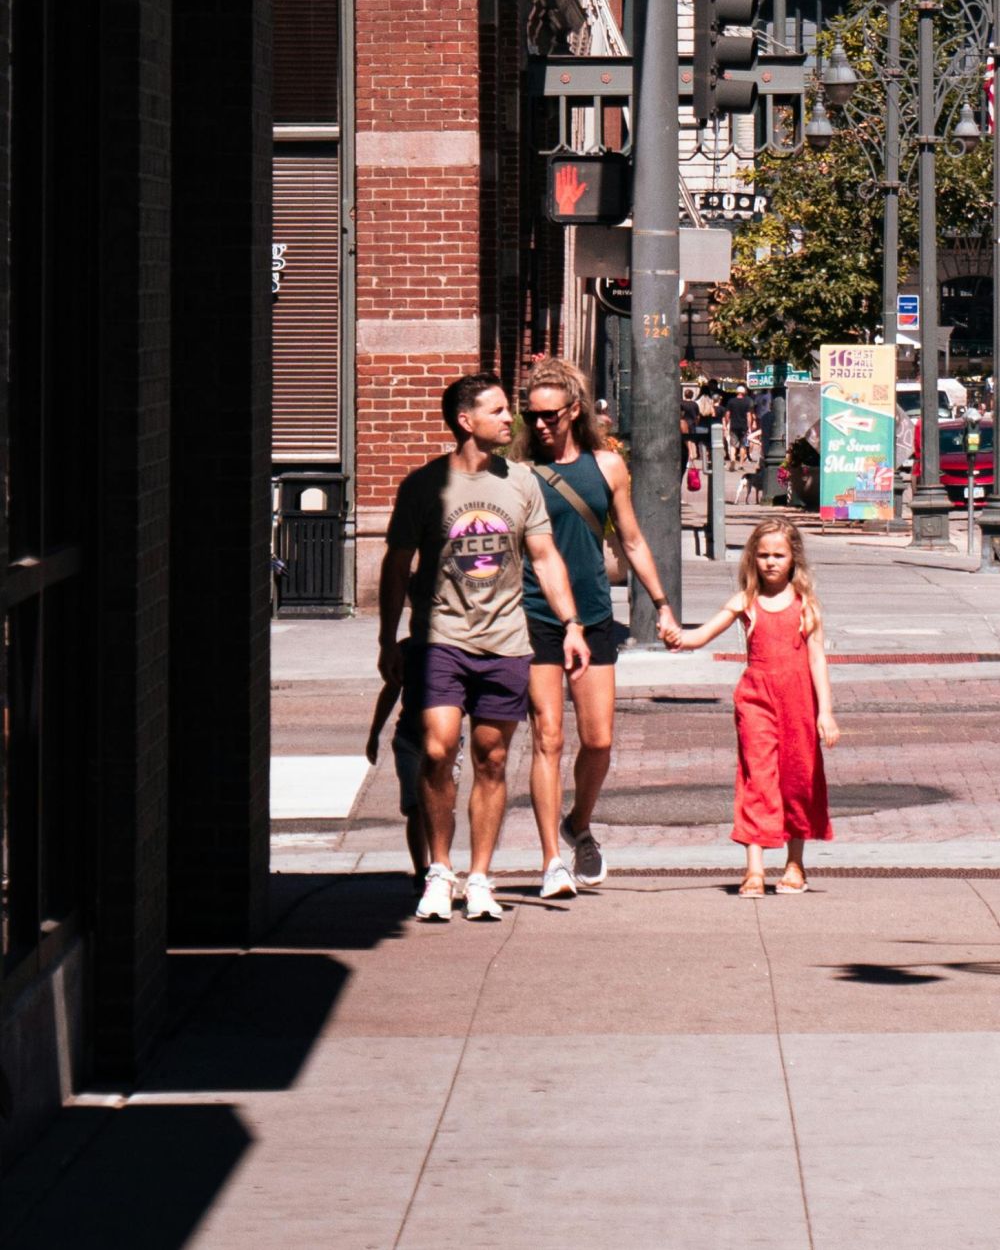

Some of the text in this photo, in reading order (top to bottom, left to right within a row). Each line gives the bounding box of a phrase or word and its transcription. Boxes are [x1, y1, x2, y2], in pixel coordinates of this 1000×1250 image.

[828, 350, 853, 367] 16
[829, 369, 874, 379] PROJECT
[823, 454, 866, 473] Mall
